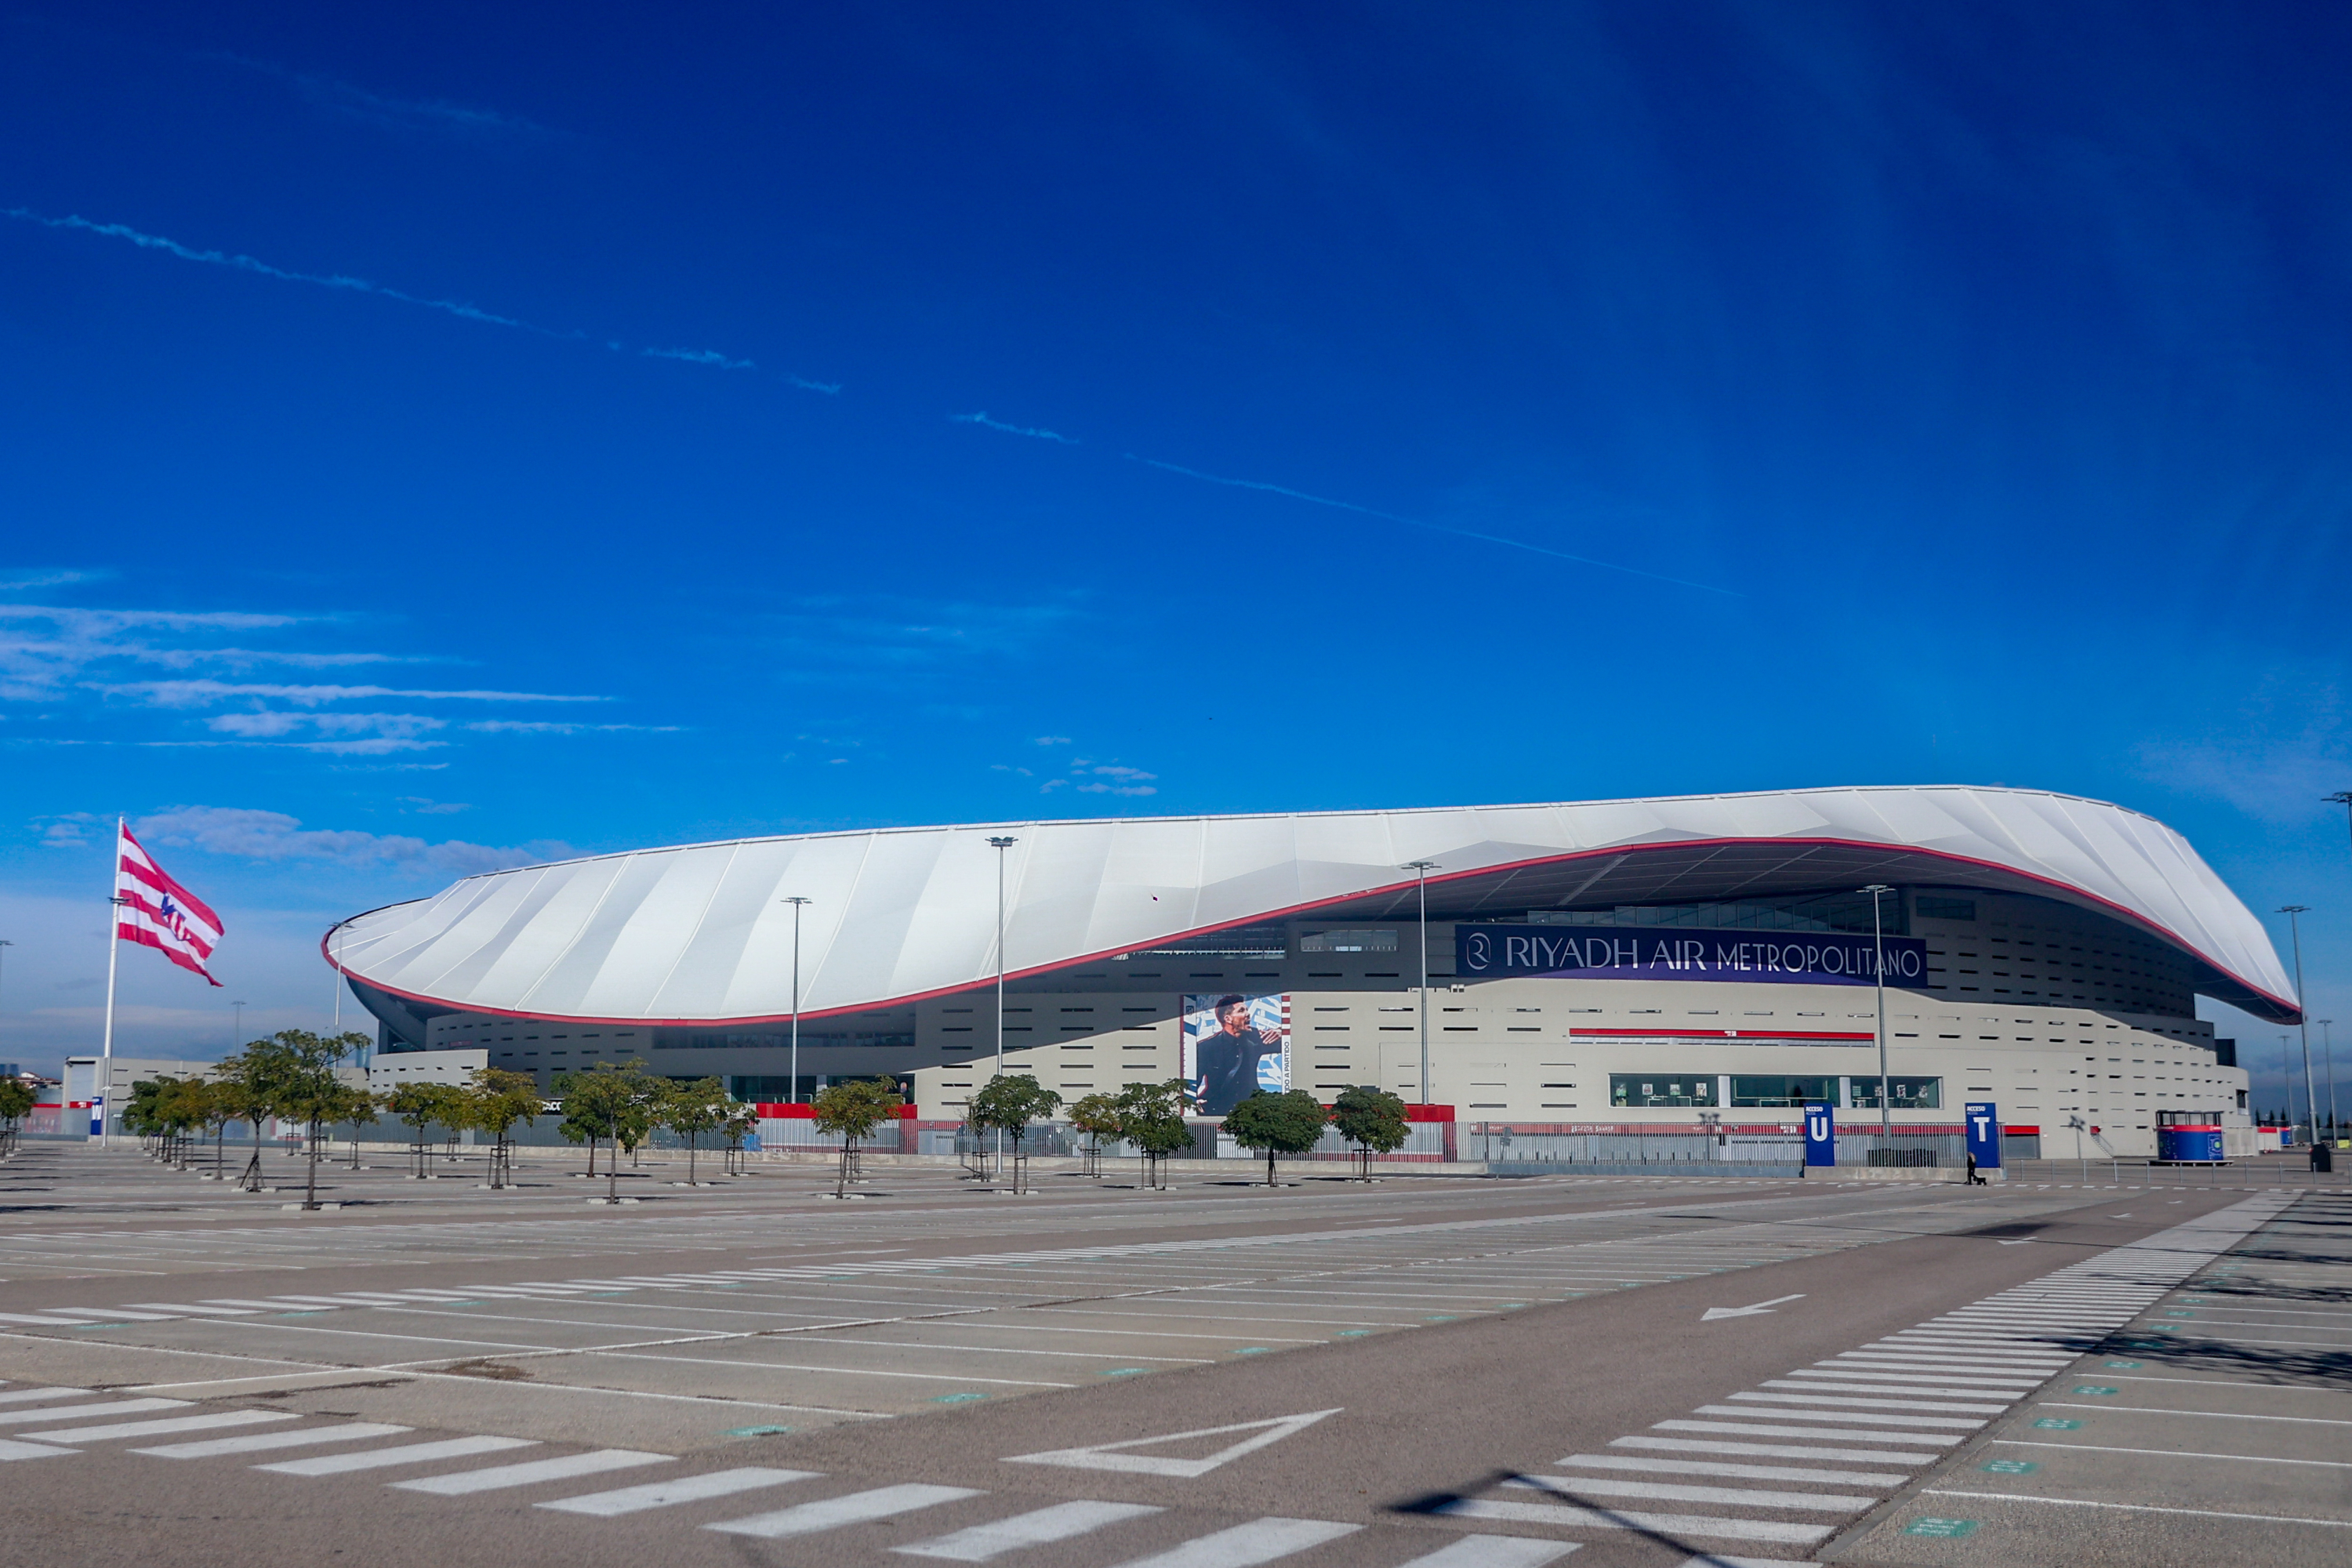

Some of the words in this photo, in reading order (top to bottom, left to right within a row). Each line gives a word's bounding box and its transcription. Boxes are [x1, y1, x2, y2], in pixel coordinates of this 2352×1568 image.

[1506, 937, 1639, 969] RIYADH
[1650, 939, 1708, 971] AIR
[1717, 942, 1920, 977] METROPOLITANO
[92, 1105, 103, 1120] W
[1811, 1117, 1828, 1142] U
[1973, 1116, 1991, 1142] T
